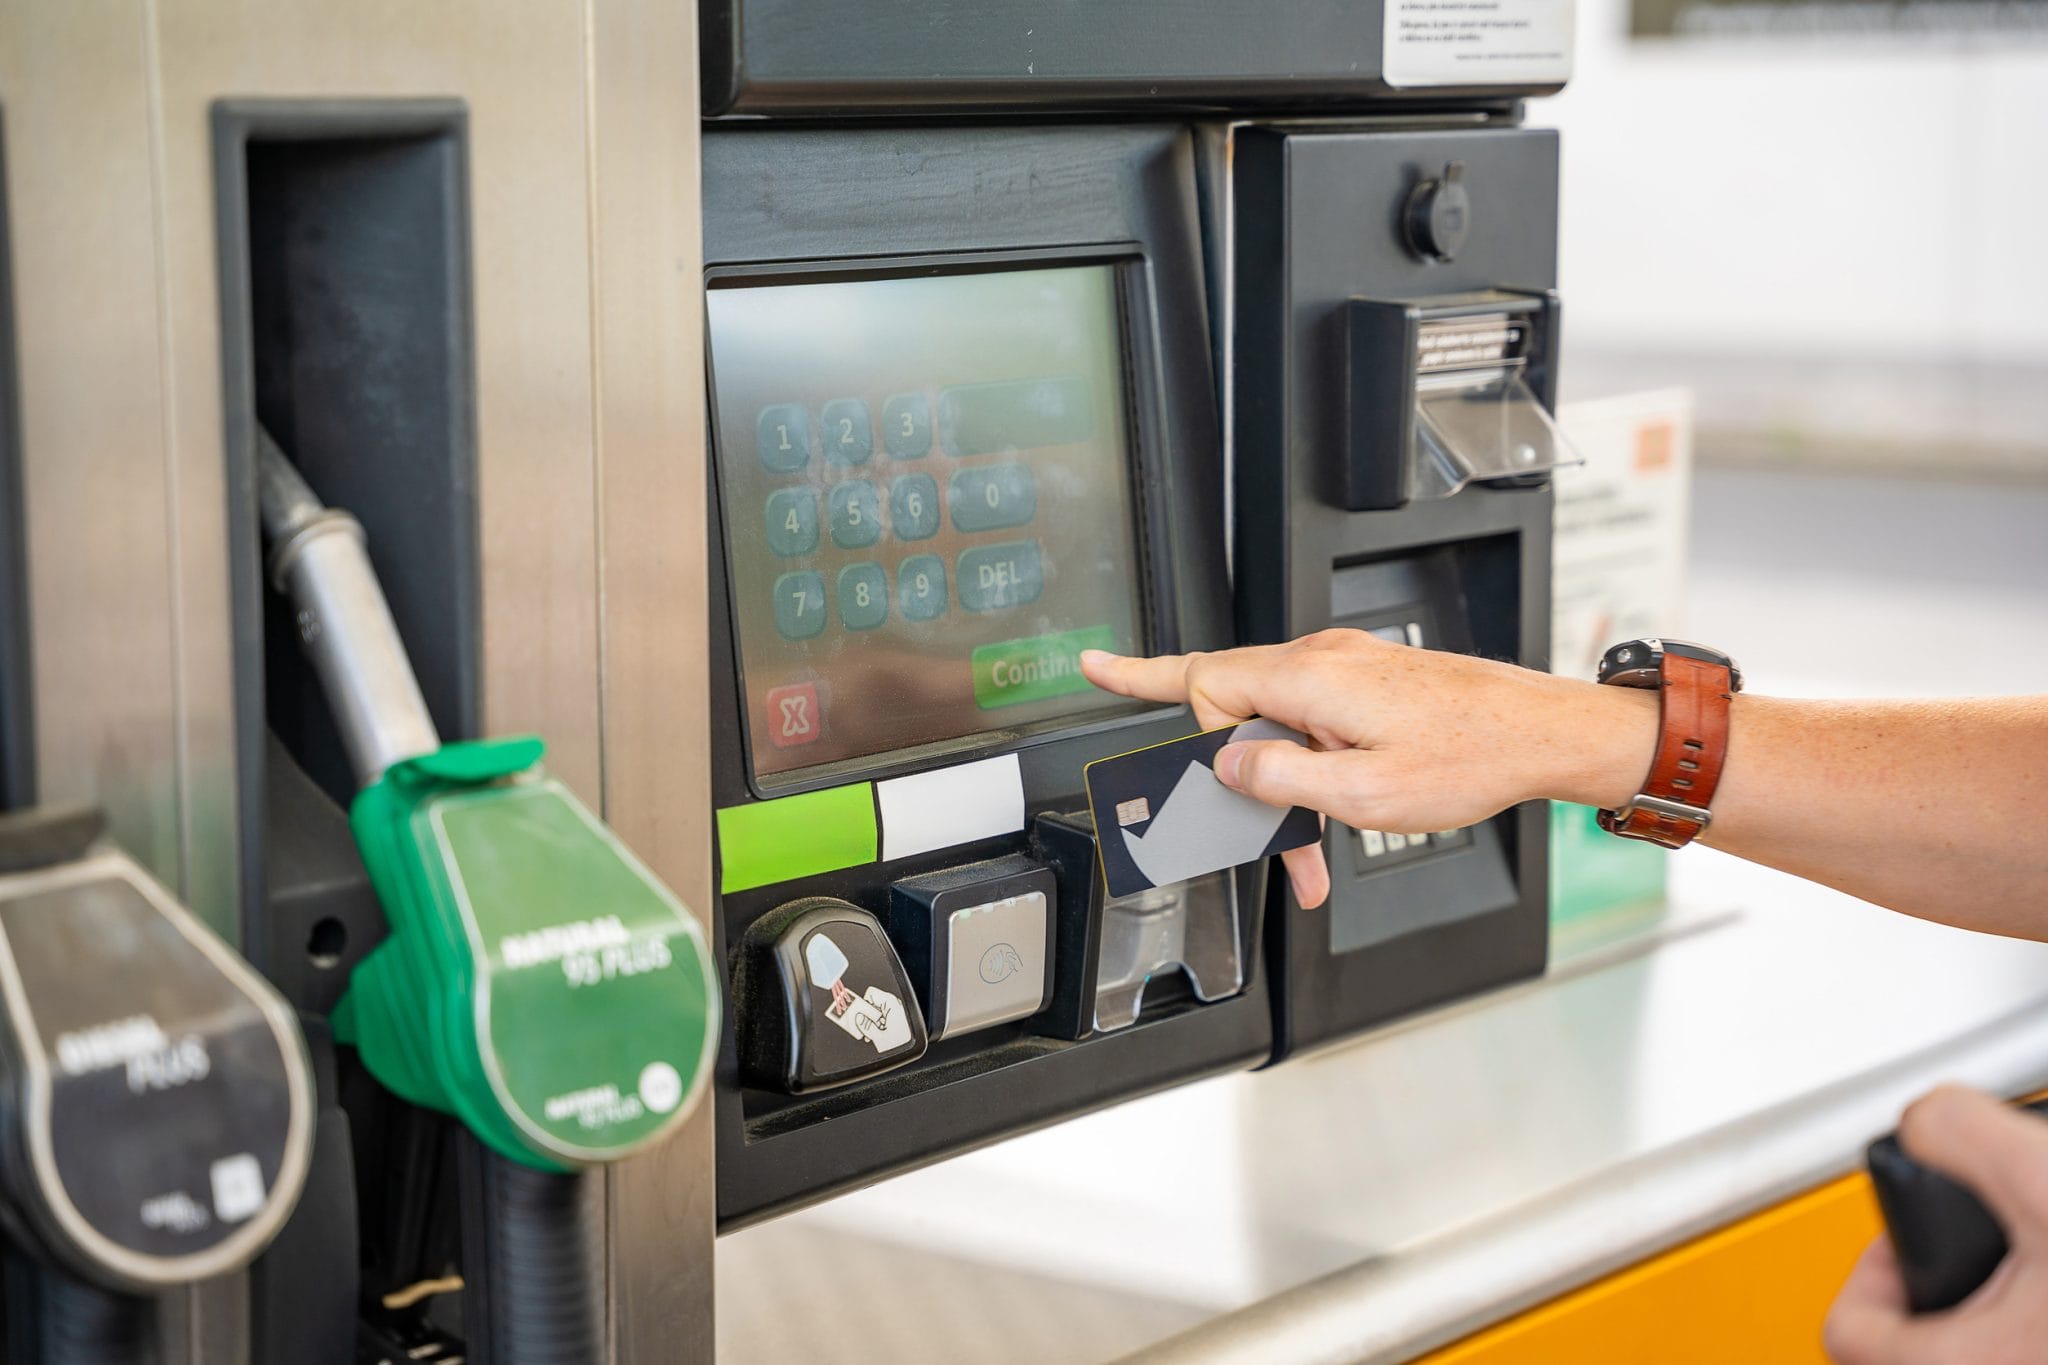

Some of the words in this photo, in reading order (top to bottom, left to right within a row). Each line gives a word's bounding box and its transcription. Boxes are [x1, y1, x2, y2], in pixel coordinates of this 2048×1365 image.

[776, 424, 792, 451] 1
[839, 417, 855, 444] 2
[900, 412, 915, 438] 3
[784, 508, 801, 534] 4
[847, 499, 862, 526] 5
[908, 492, 923, 519] 6
[985, 482, 1000, 509] 0
[792, 591, 807, 617] 7
[855, 581, 870, 608] 8
[915, 573, 930, 599] 9
[978, 560, 1022, 590] DEL
[991, 653, 1083, 689] Continu
